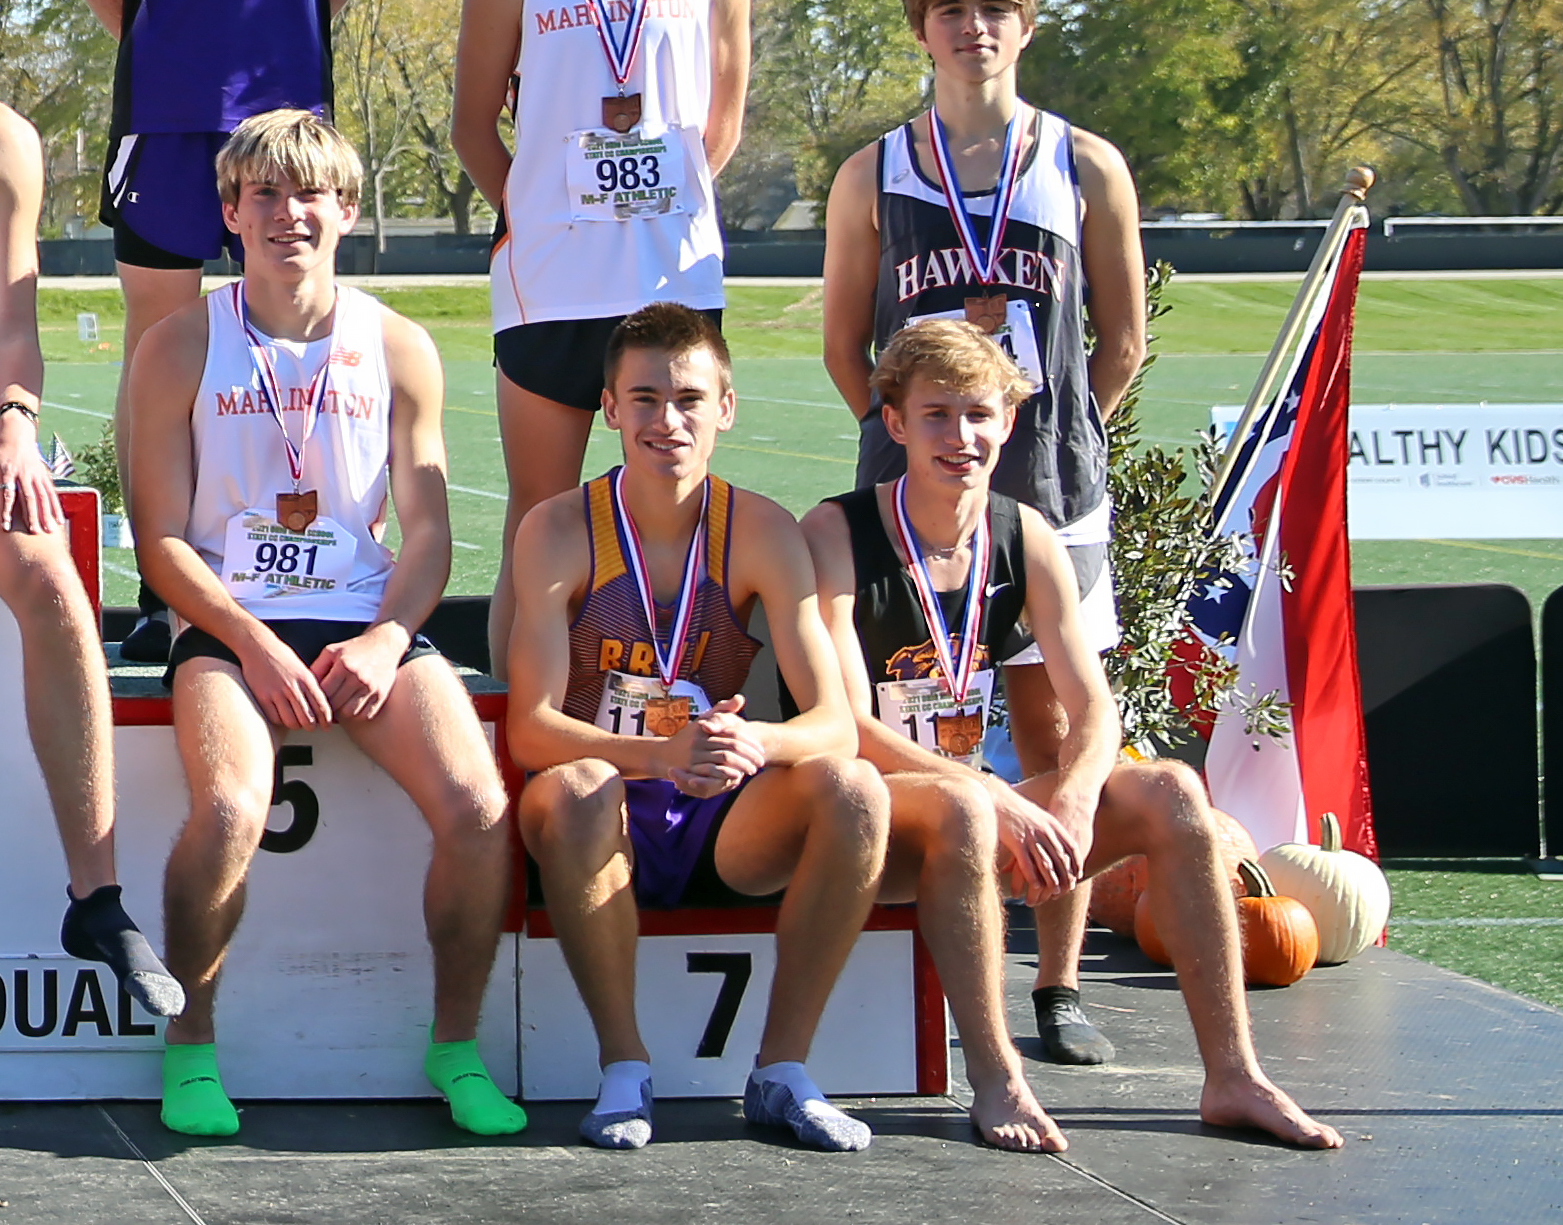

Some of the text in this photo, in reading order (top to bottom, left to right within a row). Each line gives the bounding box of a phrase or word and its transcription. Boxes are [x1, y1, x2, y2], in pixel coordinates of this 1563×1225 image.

[596, 155, 660, 192] 983
[581, 187, 677, 204] M-F ATHLETIC
[895, 248, 1068, 303] HAWKEN
[1350, 429, 1469, 466] ALTHY
[254, 542, 318, 576] 981
[231, 572, 336, 590] M-F ATHLETIC
[258, 744, 319, 854] 5
[686, 952, 752, 1058] 7
